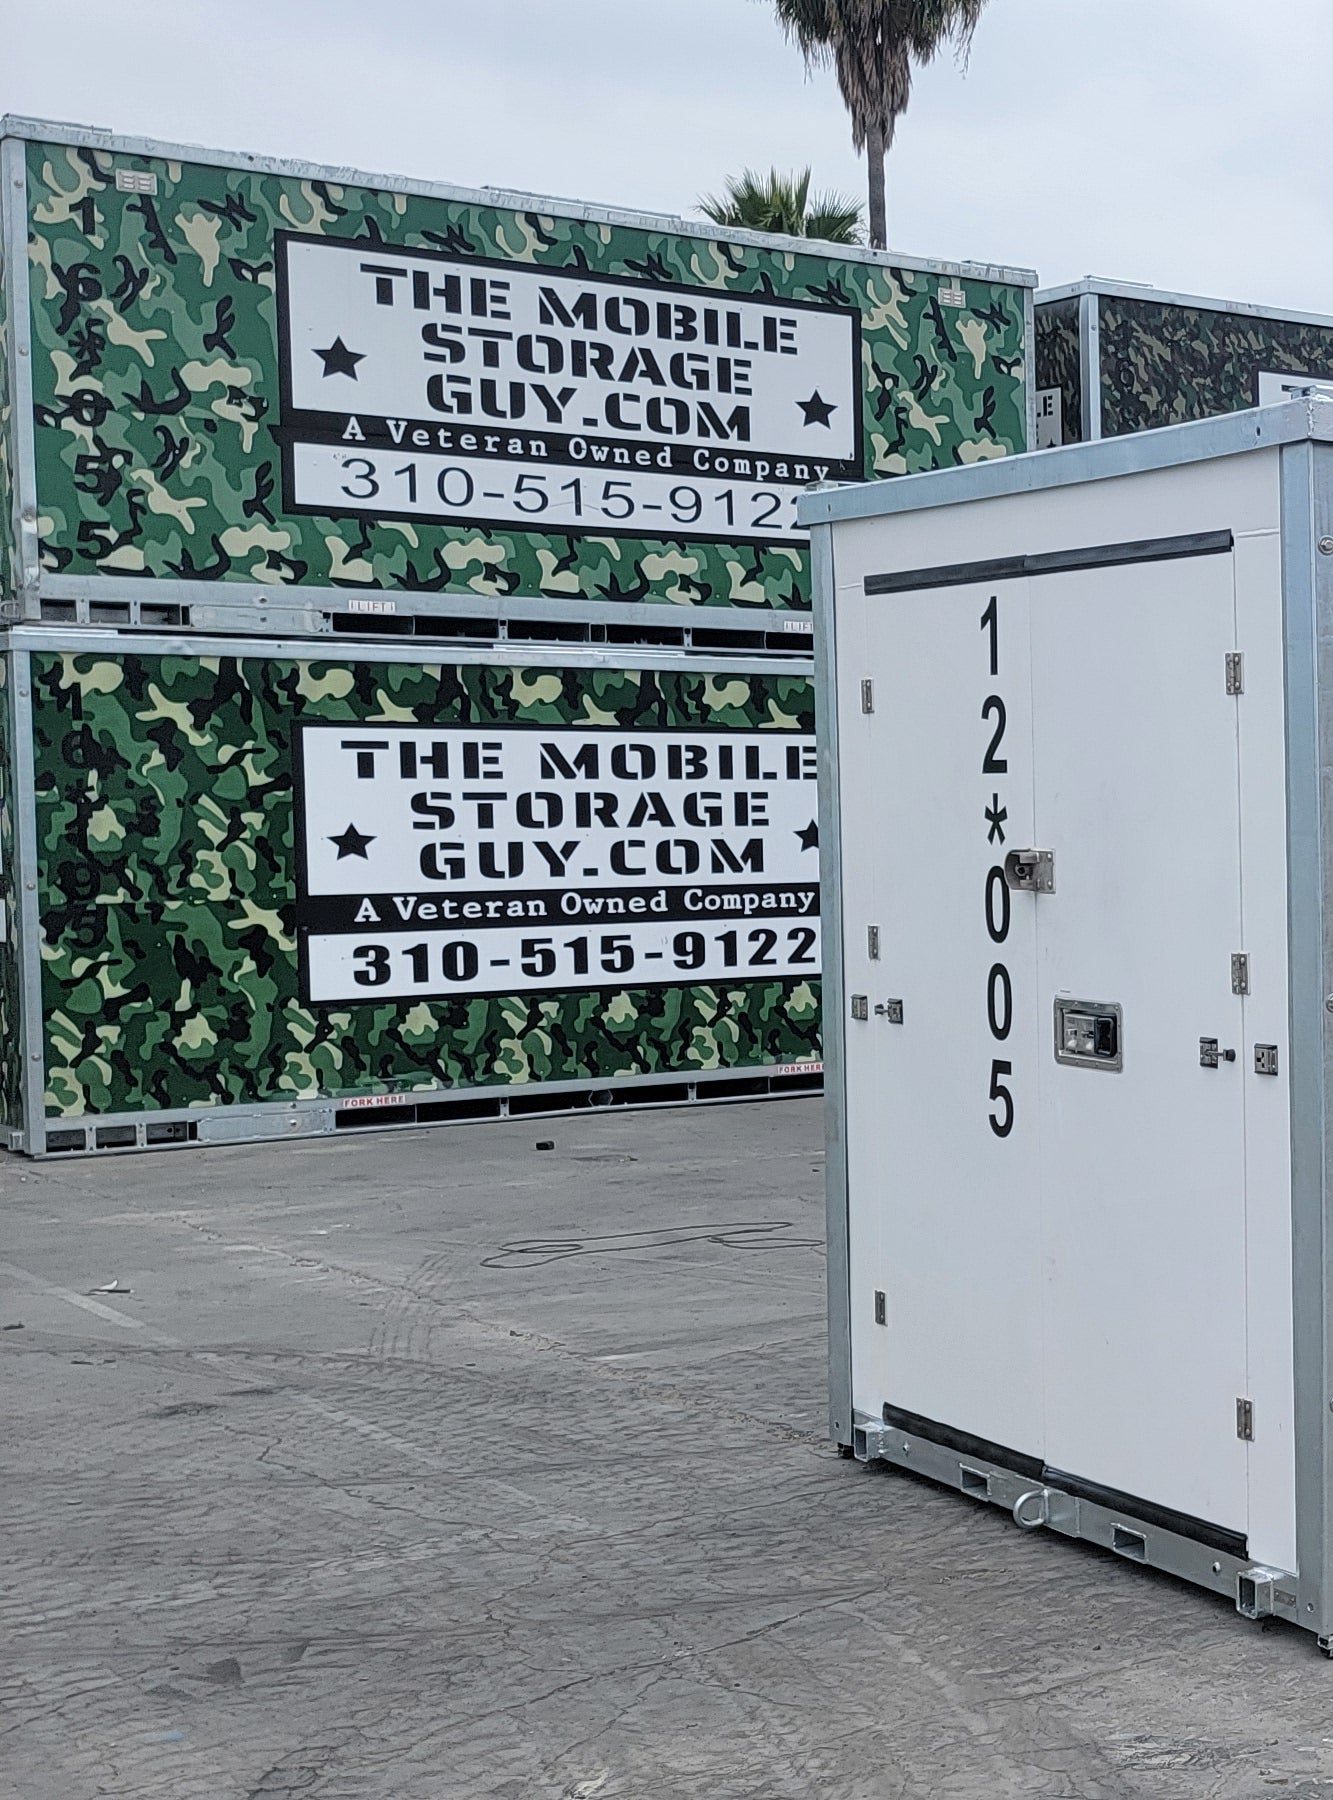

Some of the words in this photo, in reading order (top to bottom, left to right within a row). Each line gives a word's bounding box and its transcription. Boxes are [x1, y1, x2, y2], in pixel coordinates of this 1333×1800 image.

[360, 263, 512, 320] THE
[539, 287, 797, 355] MOBILE
[422, 323, 752, 396] STORAGE
[427, 374, 750, 442] GUY.COM
[342, 416, 366, 441] A
[386, 420, 547, 457] Veteran
[568, 437, 673, 468] Owned
[694, 449, 829, 481] Company
[341, 741, 503, 779] THE
[540, 743, 817, 780] MOBILE
[411, 792, 769, 829] STORAGE
[420, 838, 763, 881] GUY.COM
[354, 897, 382, 923] A
[392, 894, 548, 920] Veteran
[560, 889, 668, 915] Owned
[683, 891, 815, 917] Company
[353, 928, 817, 986] 310-515-9122
[780, 1065, 801, 1073] FORK
[345, 1098, 373, 1108] FORK
[376, 1095, 404, 1105] HERE
